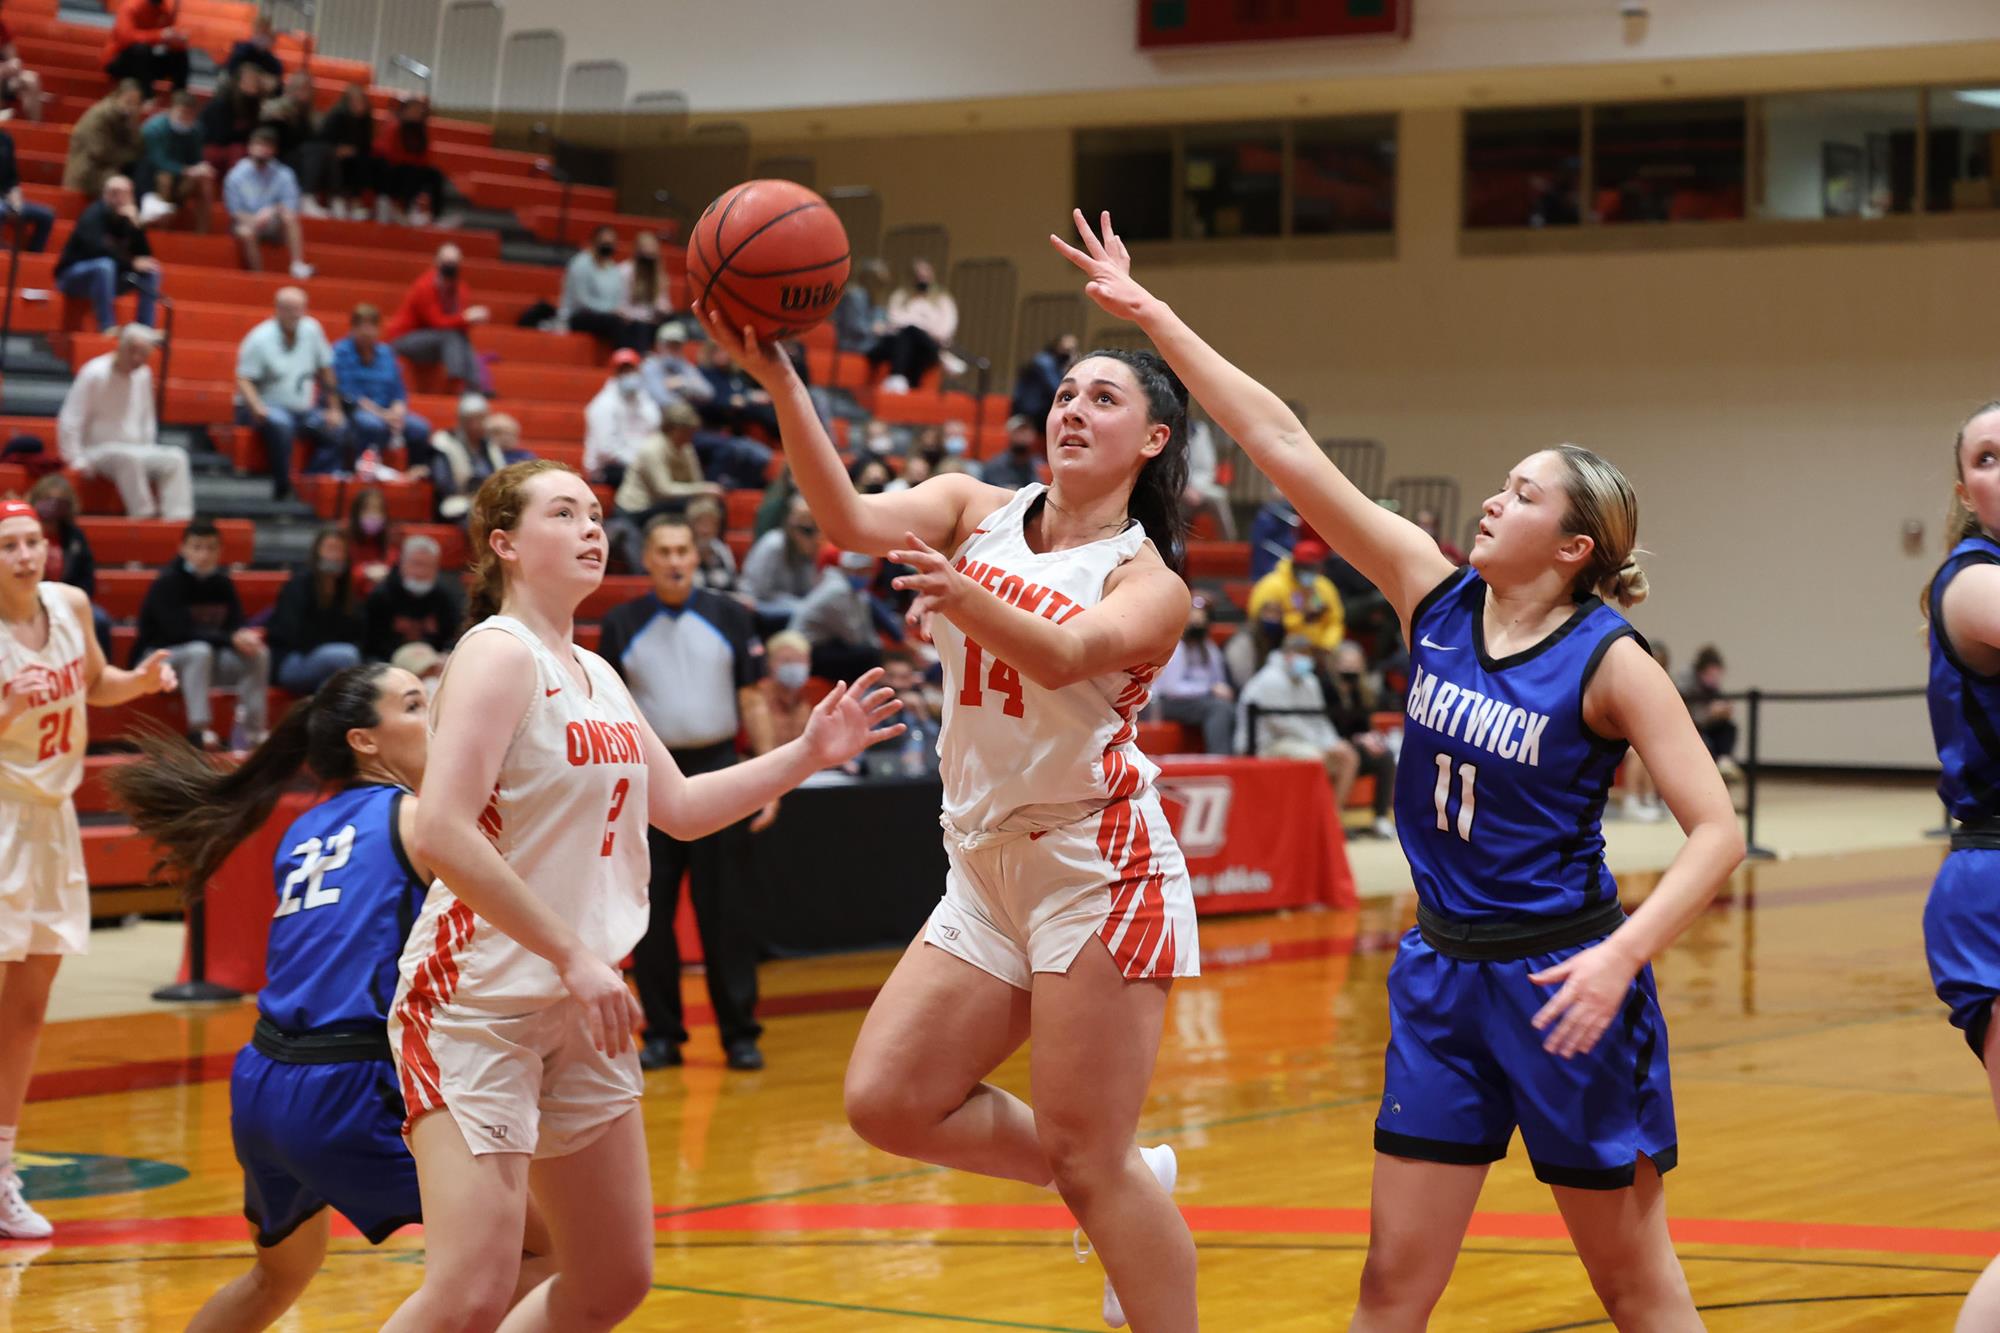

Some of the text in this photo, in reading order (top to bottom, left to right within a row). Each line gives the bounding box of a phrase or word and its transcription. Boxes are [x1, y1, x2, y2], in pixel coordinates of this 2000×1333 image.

[960, 636, 1025, 719] 14
[1406, 664, 1550, 768] HARTWICK
[38, 707, 73, 761] 21
[600, 778, 630, 857] 2
[1434, 752, 1477, 843] 11
[273, 824, 356, 918] 22
